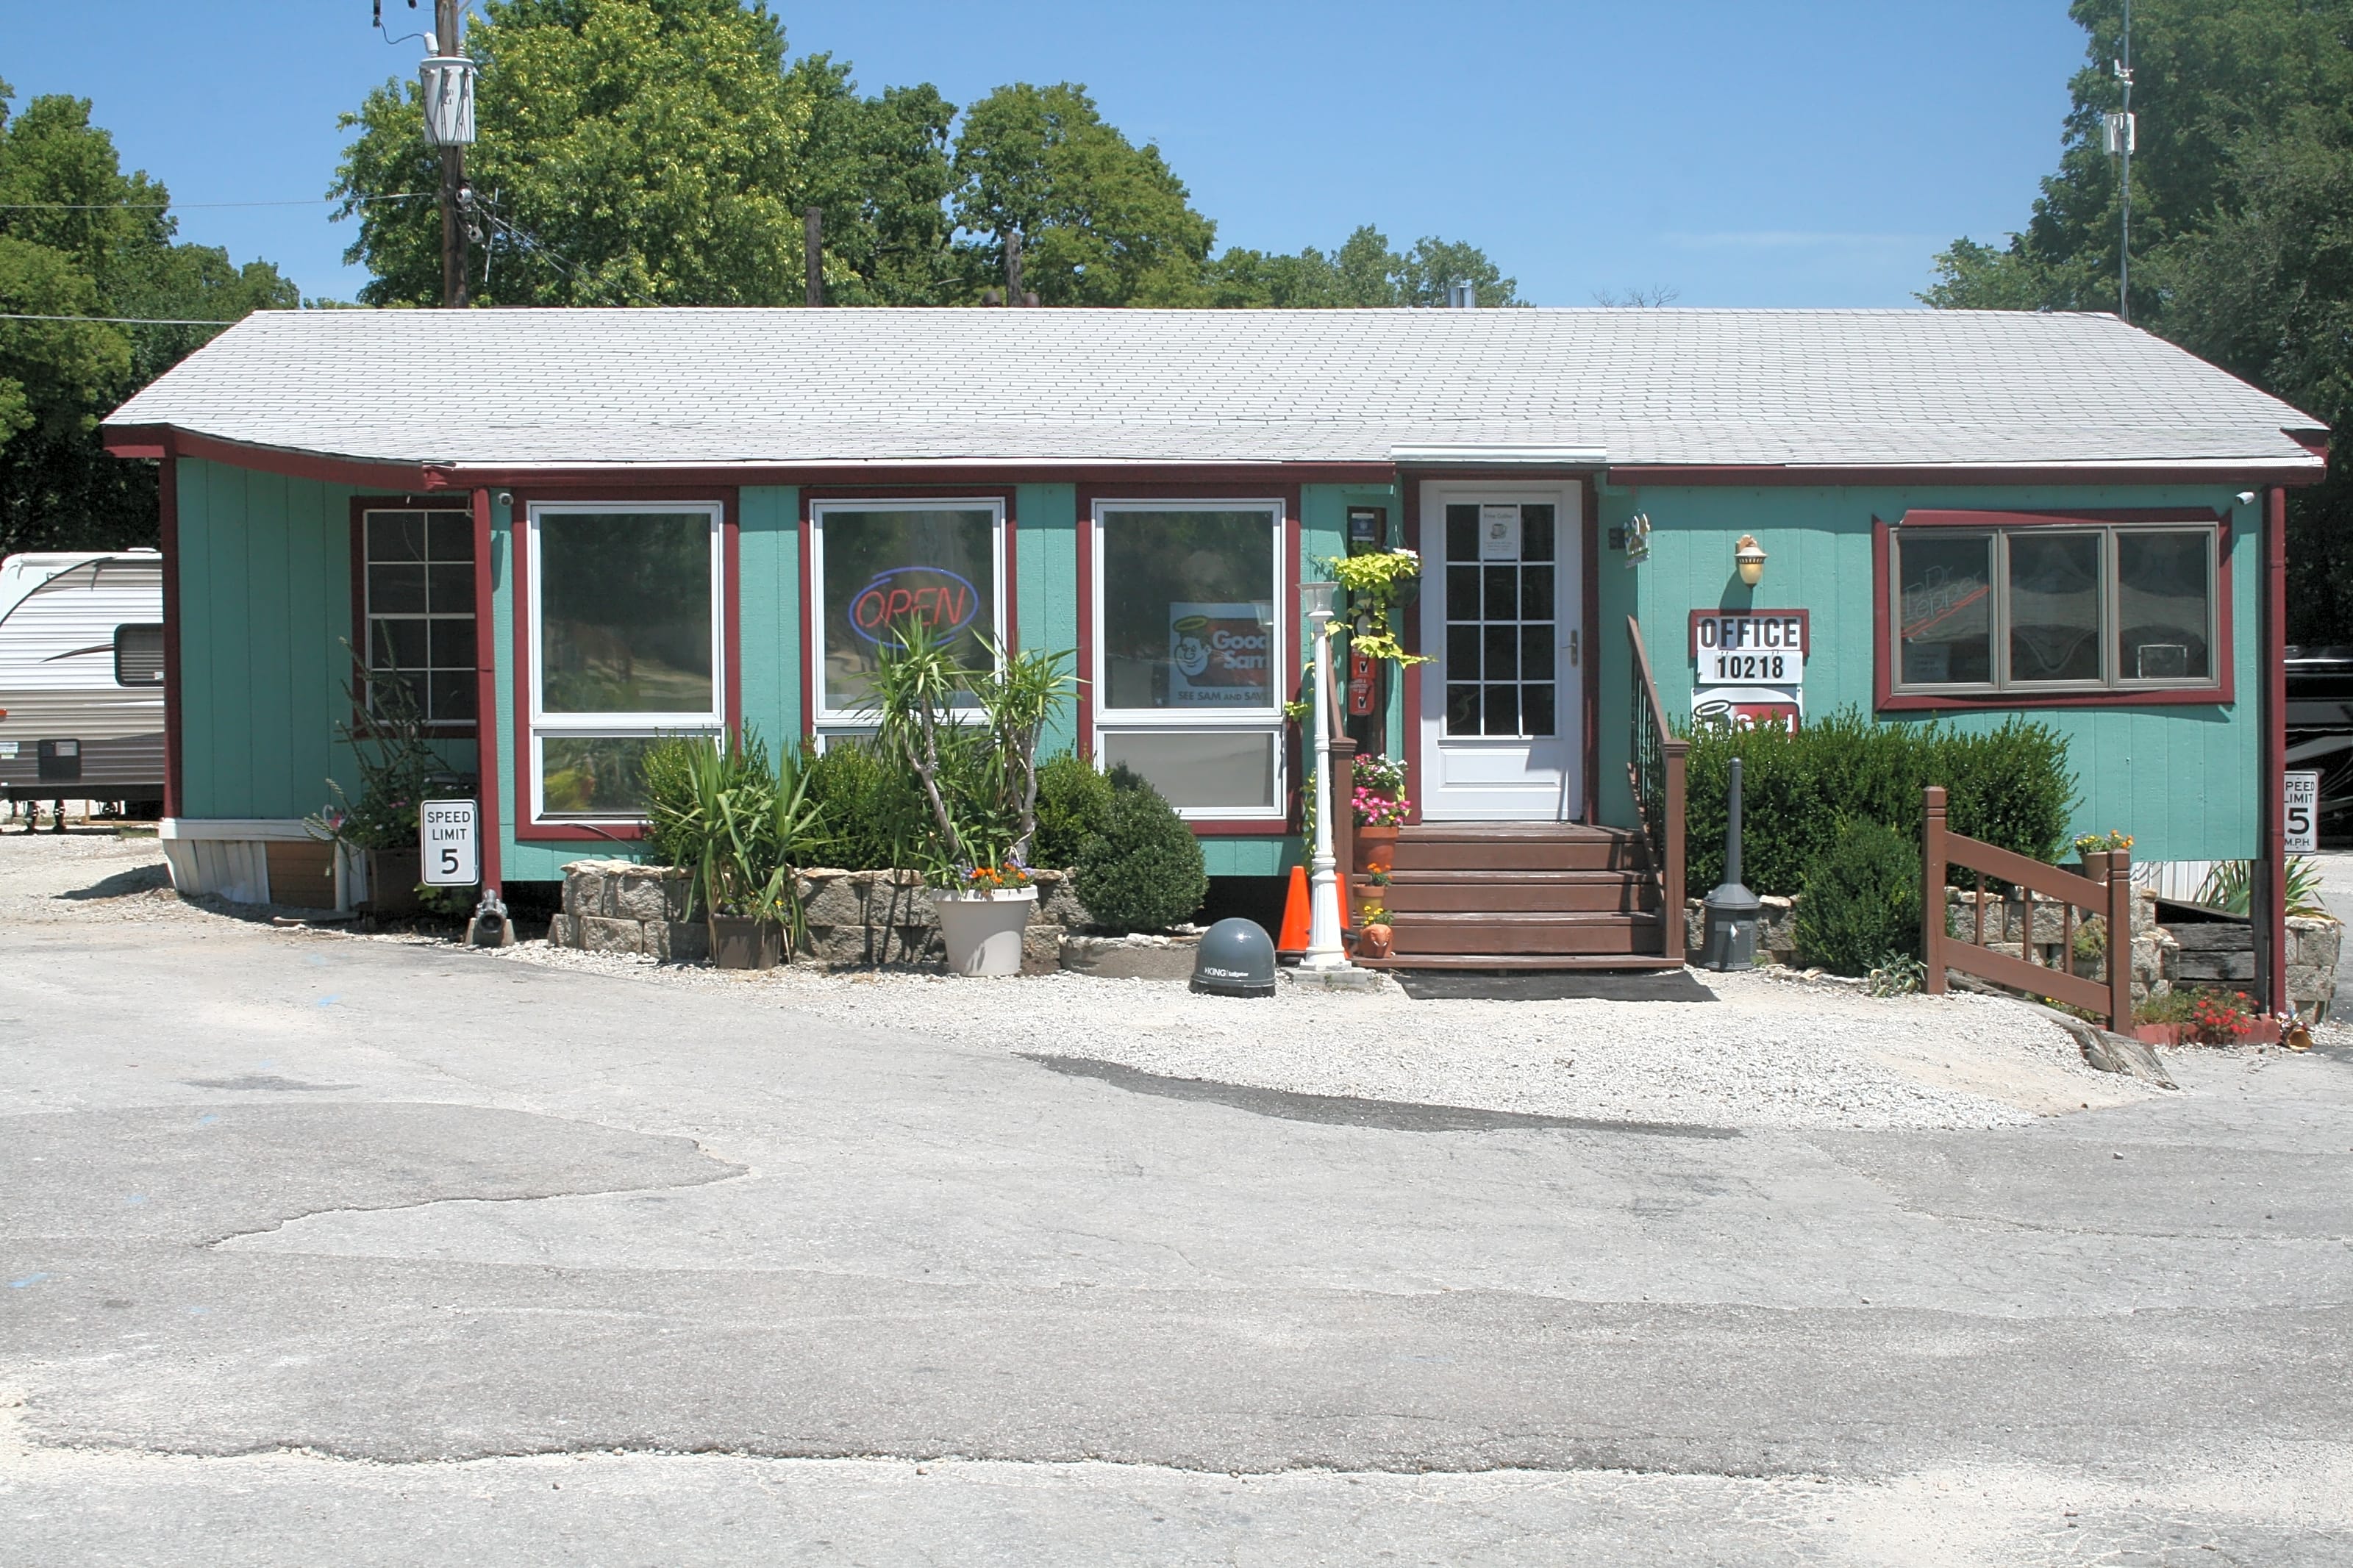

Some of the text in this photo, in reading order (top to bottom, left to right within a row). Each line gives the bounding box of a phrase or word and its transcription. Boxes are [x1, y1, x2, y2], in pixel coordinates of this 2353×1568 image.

[855, 586, 966, 629] OPEN
[1700, 617, 1799, 648] OFFICE
[1717, 655, 1784, 679] 10218
[1177, 691, 1195, 700] SEE
[1197, 691, 1221, 700] SAM
[1244, 691, 1265, 701] SAV
[1735, 714, 1793, 734] Gd
[2285, 781, 2315, 792] PEED
[427, 811, 471, 823] SPEED
[2287, 807, 2310, 835] 5
[432, 828, 467, 841] LIMIT
[441, 848, 460, 875] 5
[1207, 967, 1227, 977] KING
